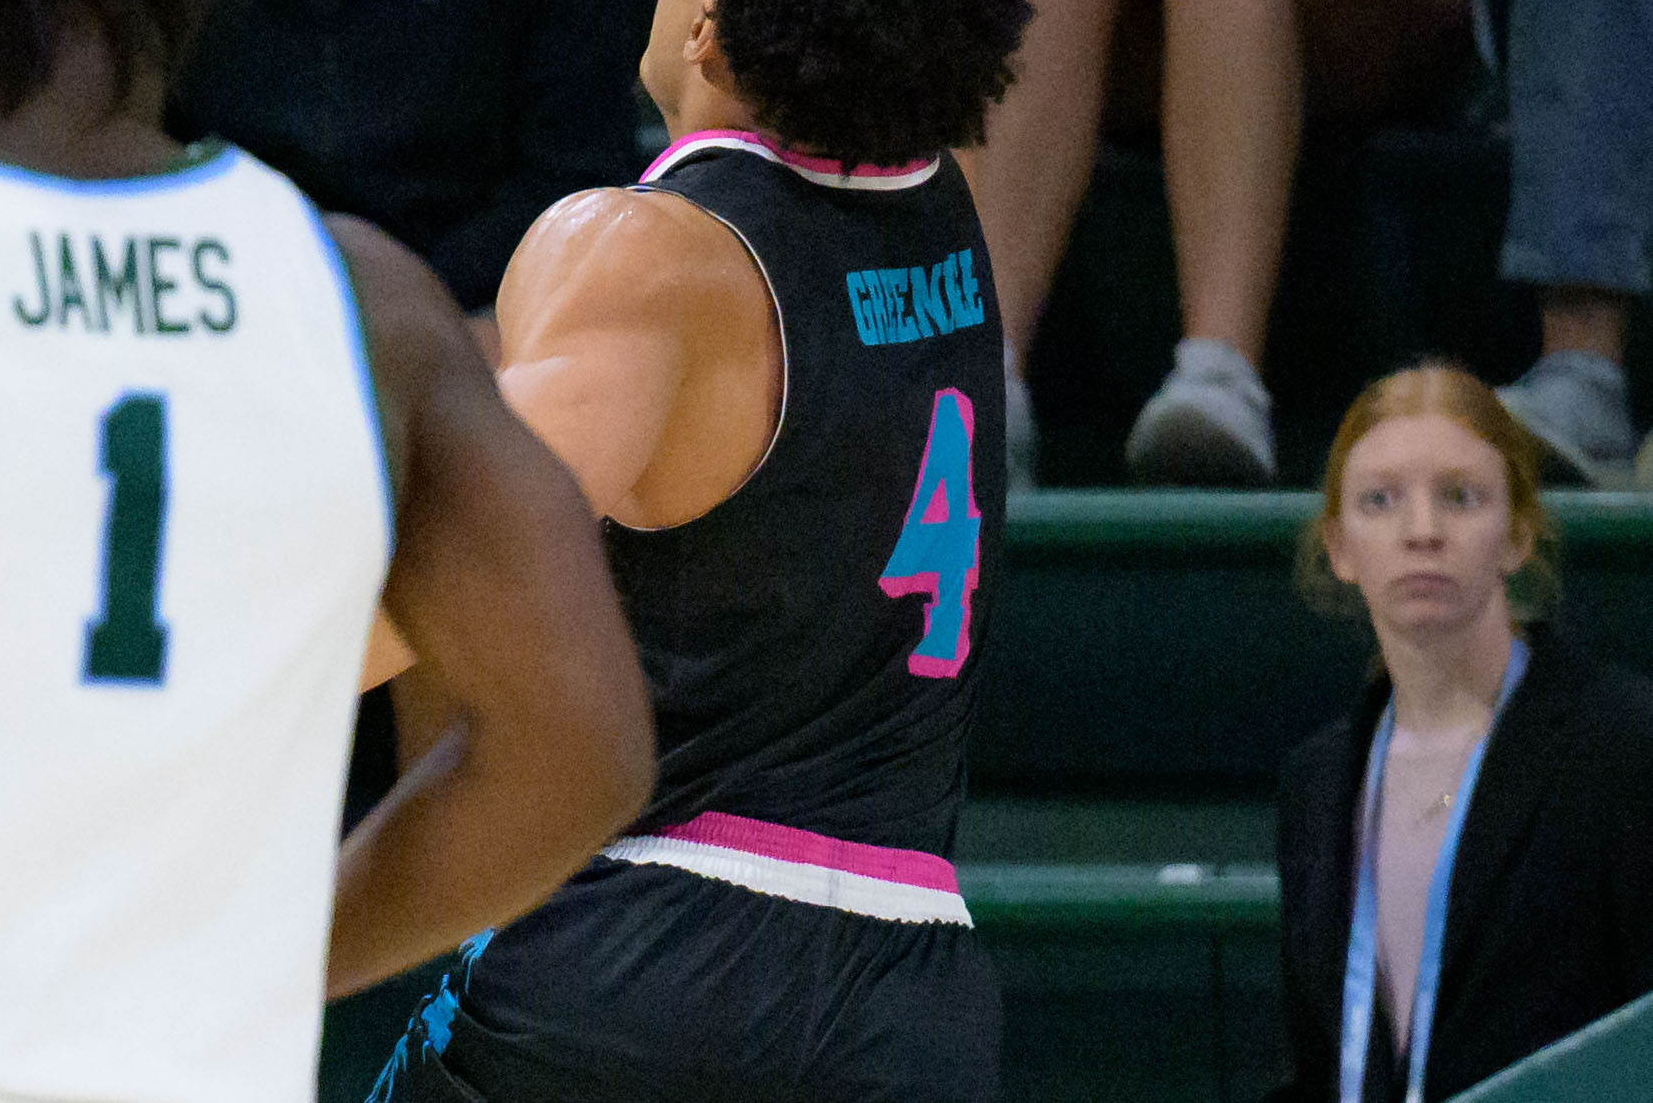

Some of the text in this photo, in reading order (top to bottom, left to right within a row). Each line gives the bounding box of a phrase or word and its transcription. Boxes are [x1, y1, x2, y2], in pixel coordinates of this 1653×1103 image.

[13, 229, 239, 336] JAMES
[80, 388, 173, 688] 1
[878, 387, 981, 679] 4
